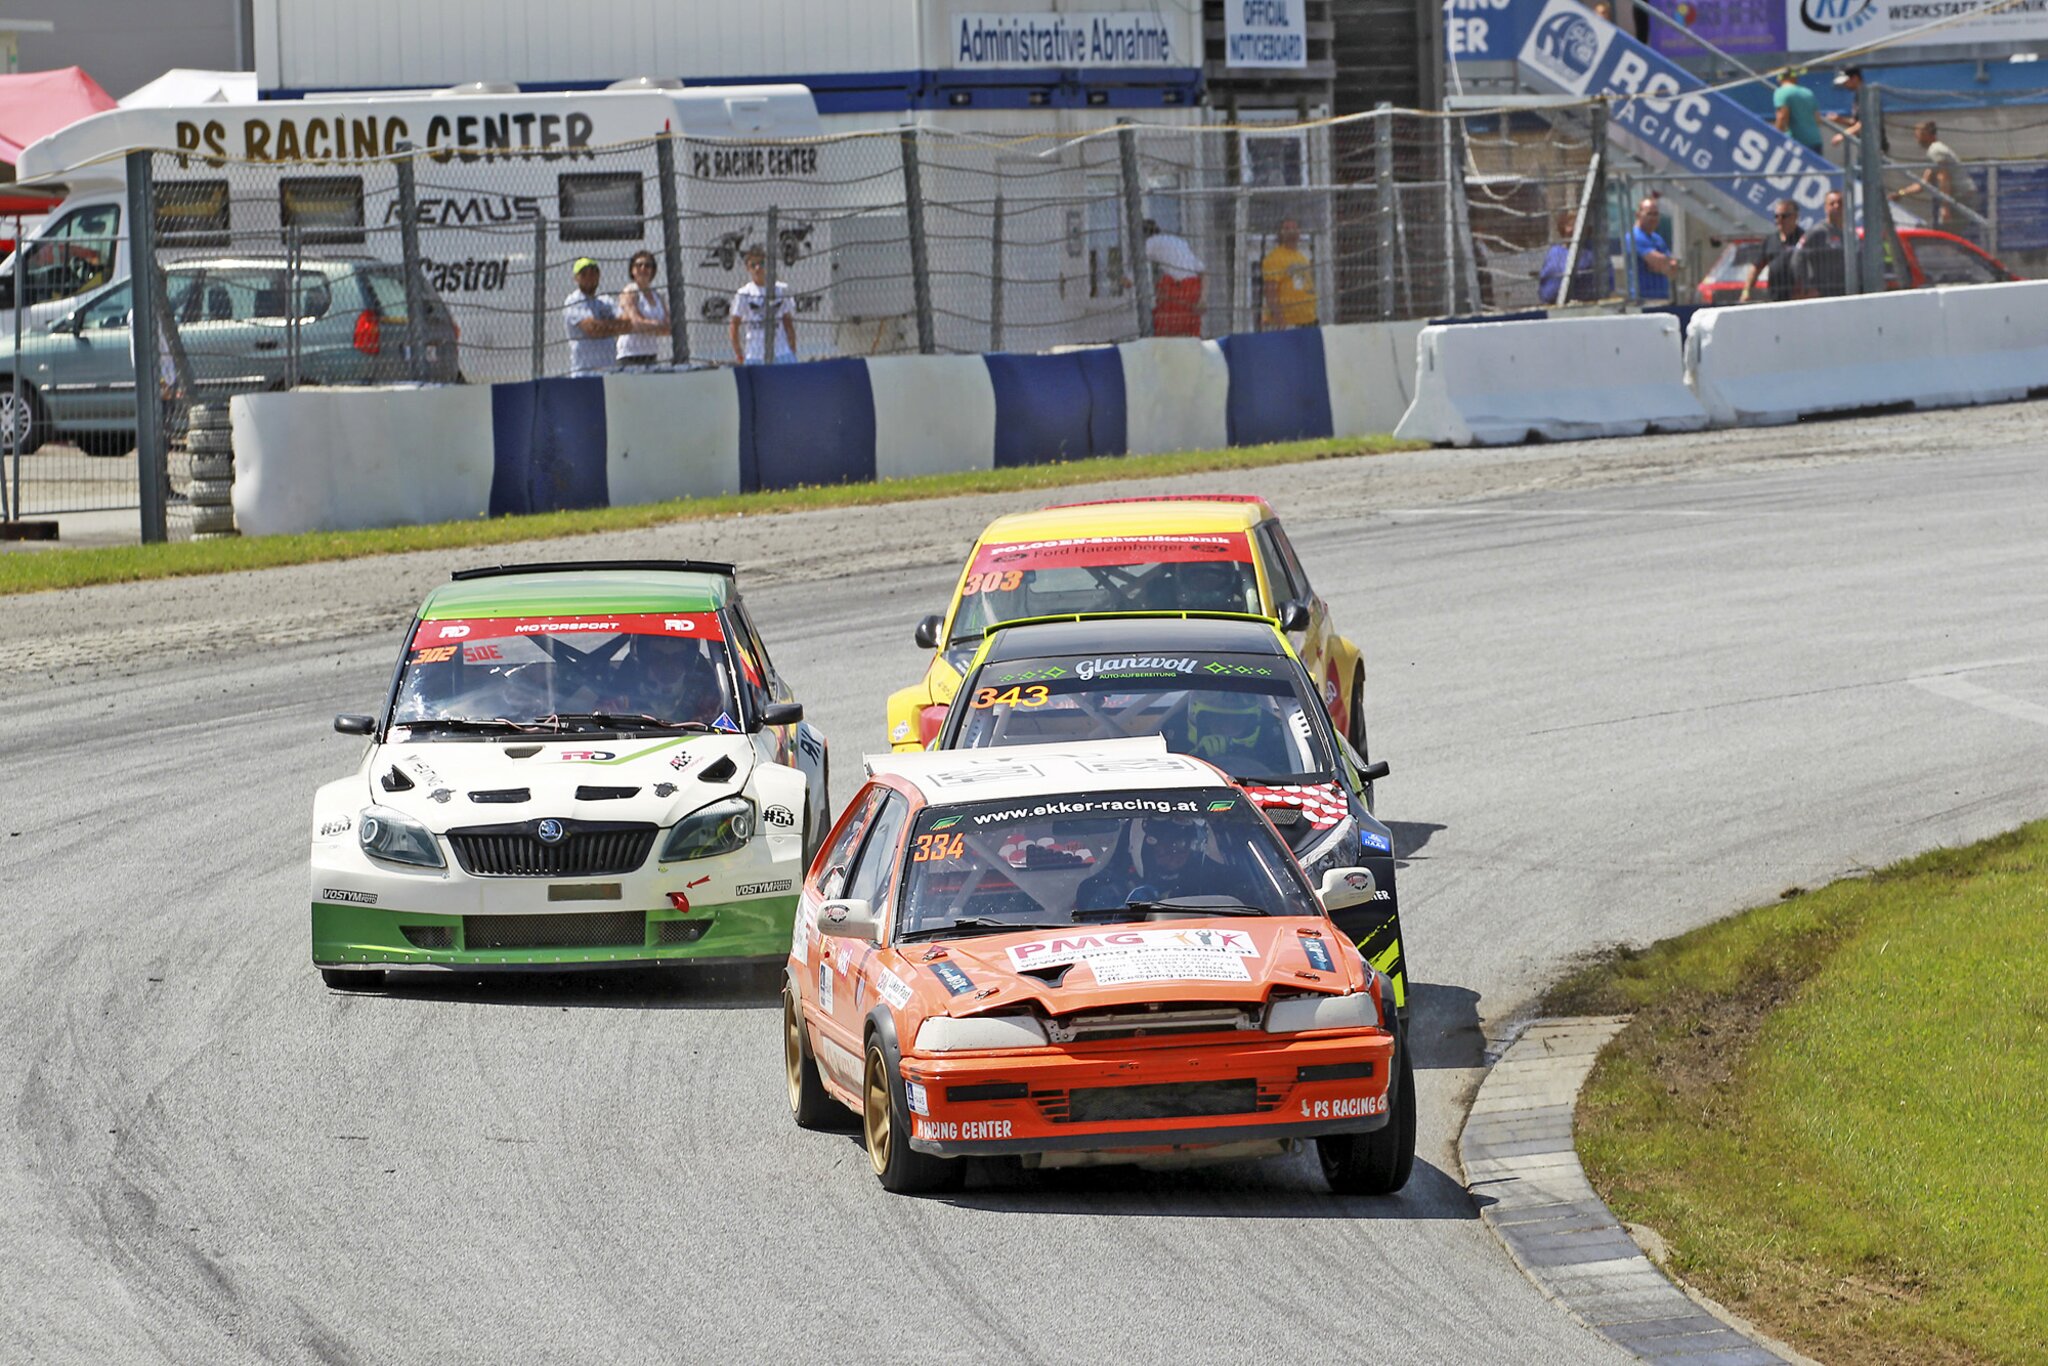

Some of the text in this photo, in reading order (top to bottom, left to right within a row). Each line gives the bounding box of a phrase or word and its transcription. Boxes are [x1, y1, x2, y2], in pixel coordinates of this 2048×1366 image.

[959, 18, 1169, 63] Administrative Abnahme
[1230, 34, 1302, 60] NOTICEBOARD
[176, 112, 595, 170] PS RACING CENTER
[715, 150, 764, 177] RACING
[768, 148, 818, 175] CENTER
[1033, 548, 1070, 558] Ford
[962, 571, 1023, 596] 303
[515, 622, 620, 632] MOTORSPORT
[411, 646, 458, 665] 302
[1075, 657, 1198, 681] Glanzvoll
[970, 685, 1049, 709] 343
[763, 808, 794, 827] #53
[973, 798, 1199, 825] www.ekker-racing.at
[913, 832, 965, 862] 334
[1014, 933, 1145, 959] PMG
[1314, 1100, 1329, 1118] PS
[1332, 1096, 1376, 1117] RACING
[962, 1120, 1013, 1139] CENTER
